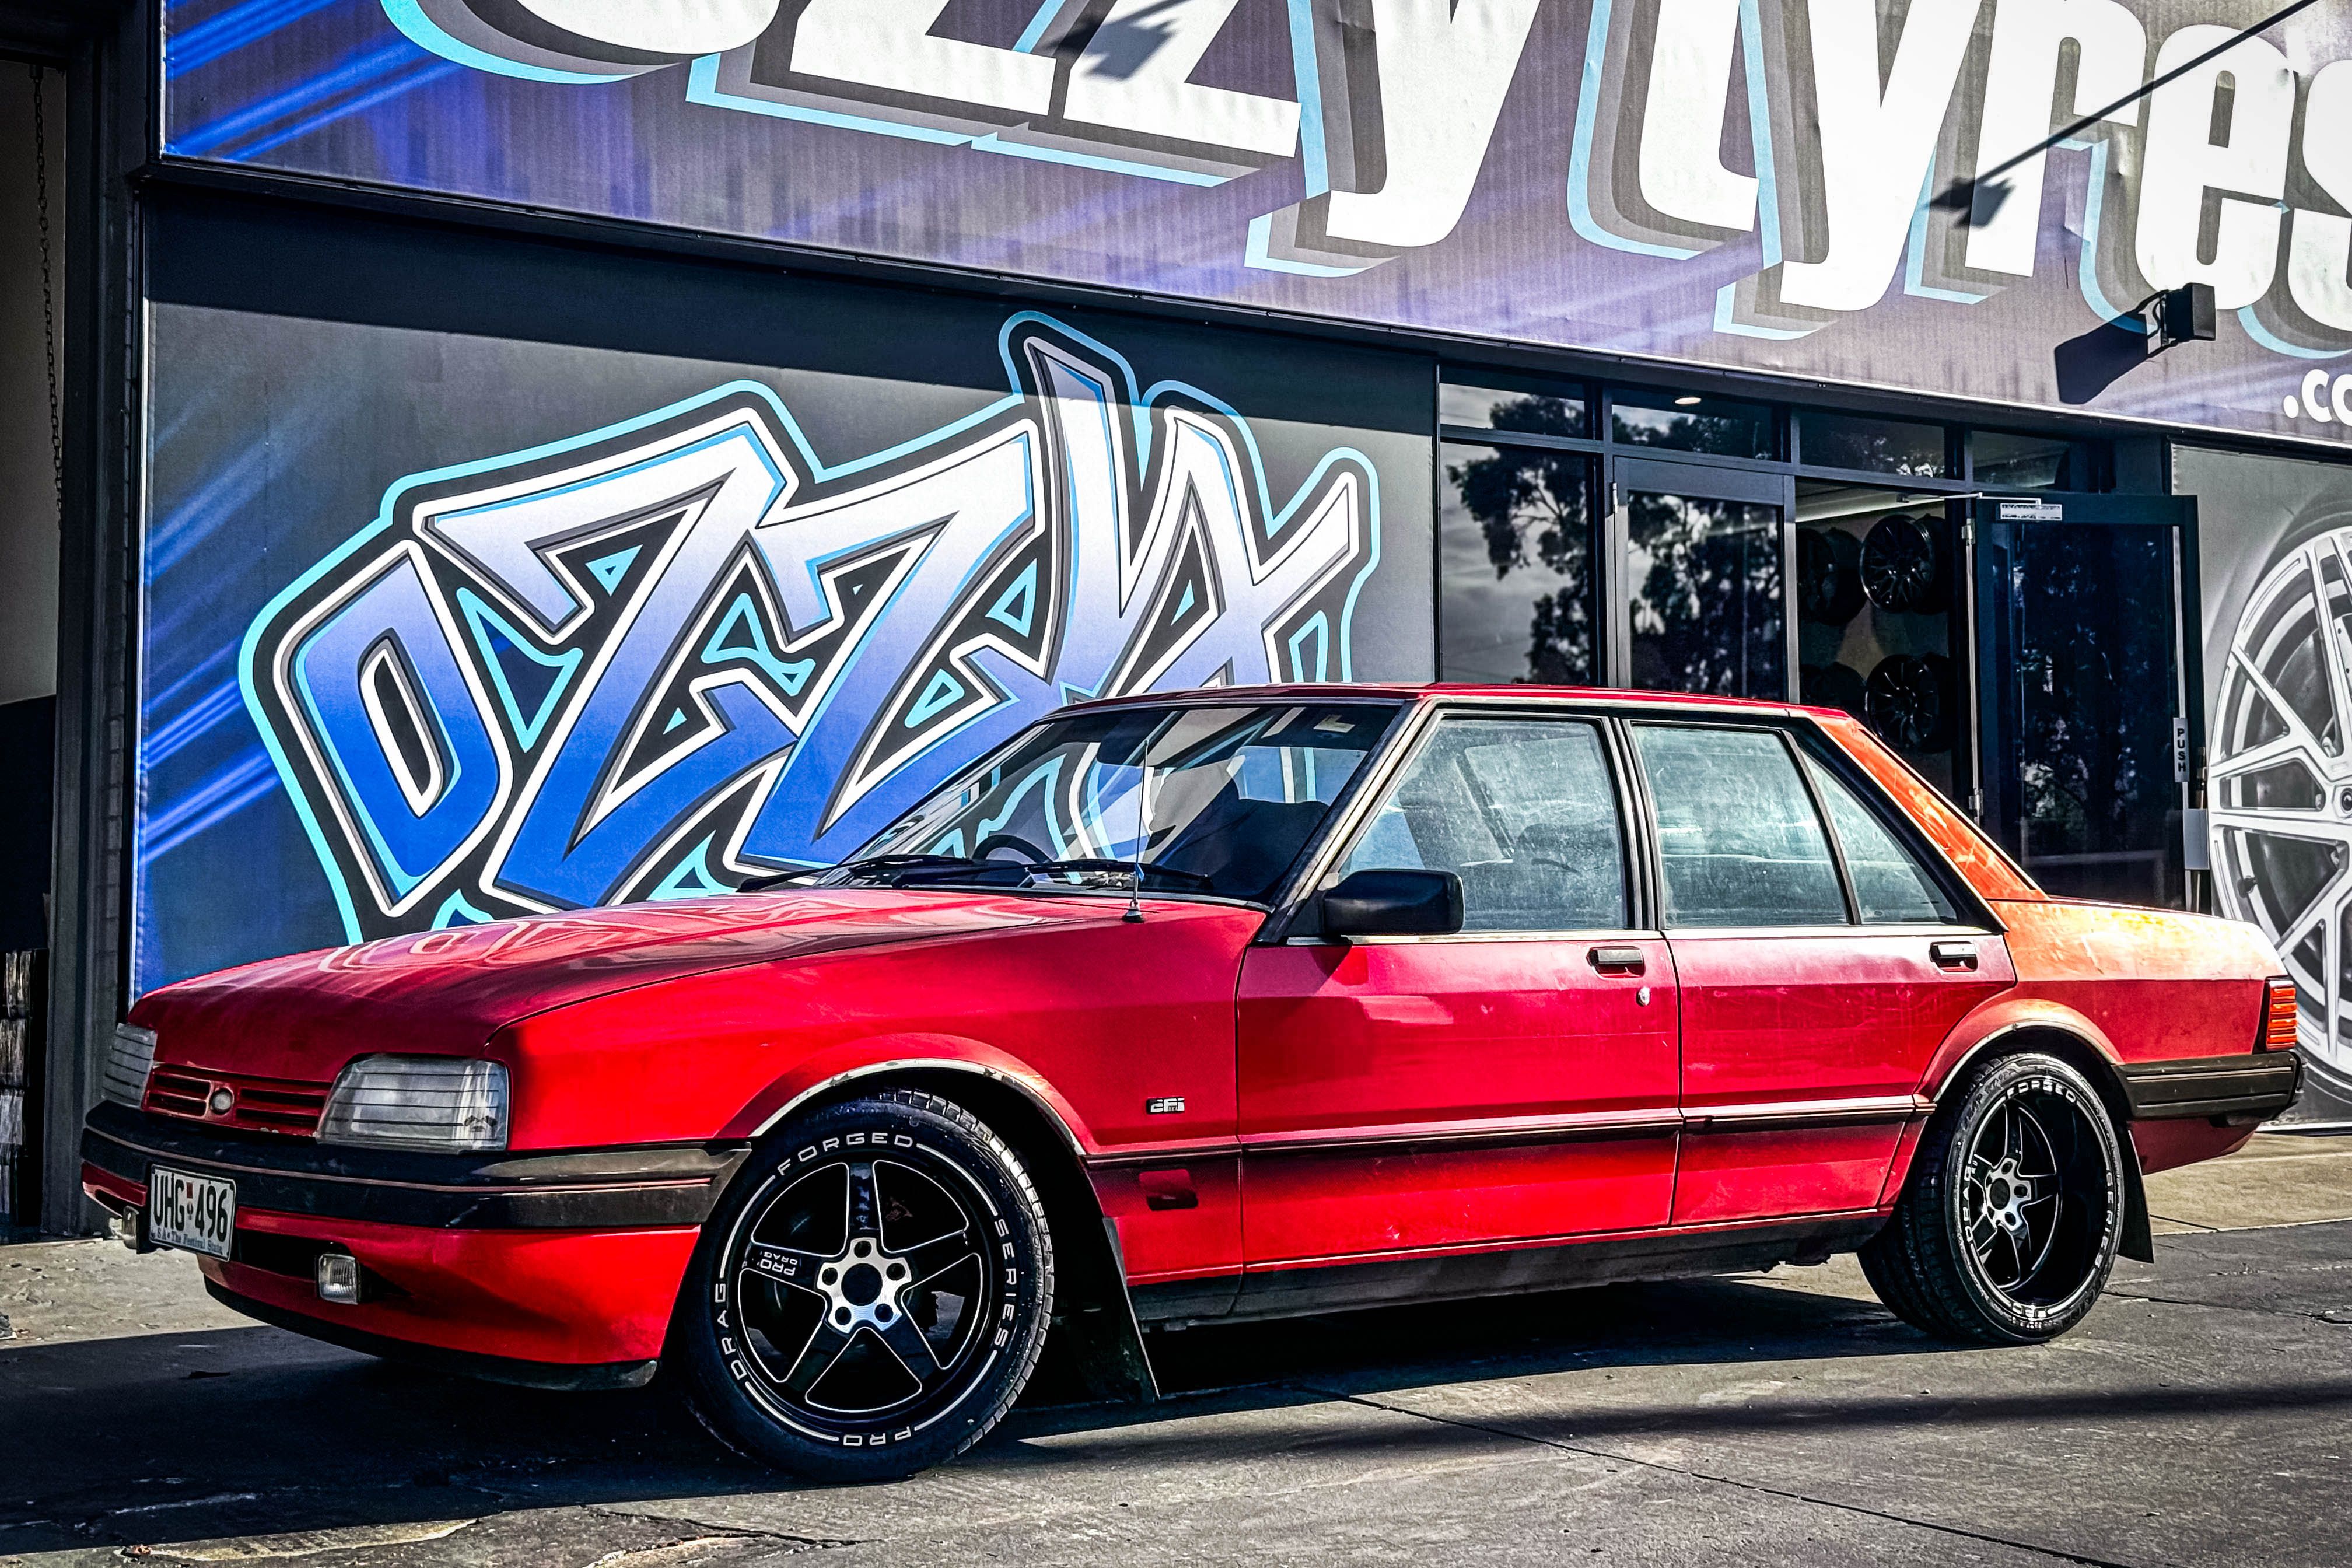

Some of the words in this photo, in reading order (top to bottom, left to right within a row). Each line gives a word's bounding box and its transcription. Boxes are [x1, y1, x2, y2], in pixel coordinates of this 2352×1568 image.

[2177, 727, 2186, 772] PUSH
[2006, 1079, 2076, 1103] FORGED
[777, 1132, 913, 1175] FORGED
[153, 1174, 184, 1231] UHG
[195, 1184, 228, 1242] 496
[1962, 1165, 1973, 1242] DRAG
[2095, 1172, 2114, 1268] SERIES
[760, 1258, 796, 1276] PRO
[763, 1251, 798, 1265] DRAG
[993, 1218, 1017, 1348] SERIES
[715, 1283, 747, 1380] DRAG
[843, 1426, 913, 1447] PRO
